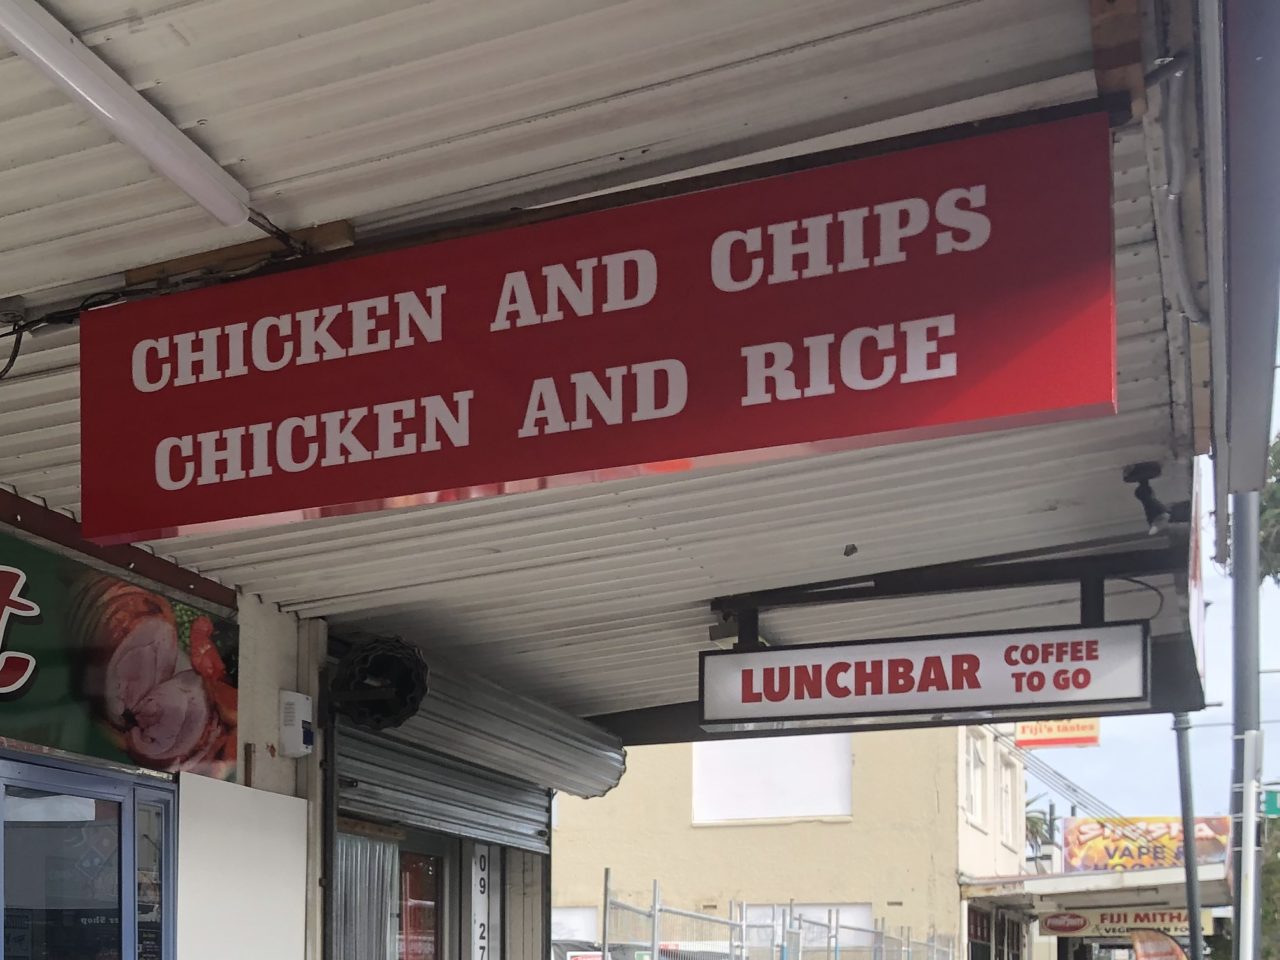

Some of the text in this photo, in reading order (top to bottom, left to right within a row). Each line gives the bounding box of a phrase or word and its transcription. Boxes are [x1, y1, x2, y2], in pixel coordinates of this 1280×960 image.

[131, 184, 992, 394] CHICKEN AND CHIPS
[154, 313, 957, 491] CHICKEN AND RICE
[1003, 639, 1099, 667] COFFEE
[740, 653, 982, 704] LUNCHBAR
[1011, 668, 1092, 693] TO GO
[1104, 844, 1166, 860] VAPE
[1100, 911, 1128, 924] FIJI
